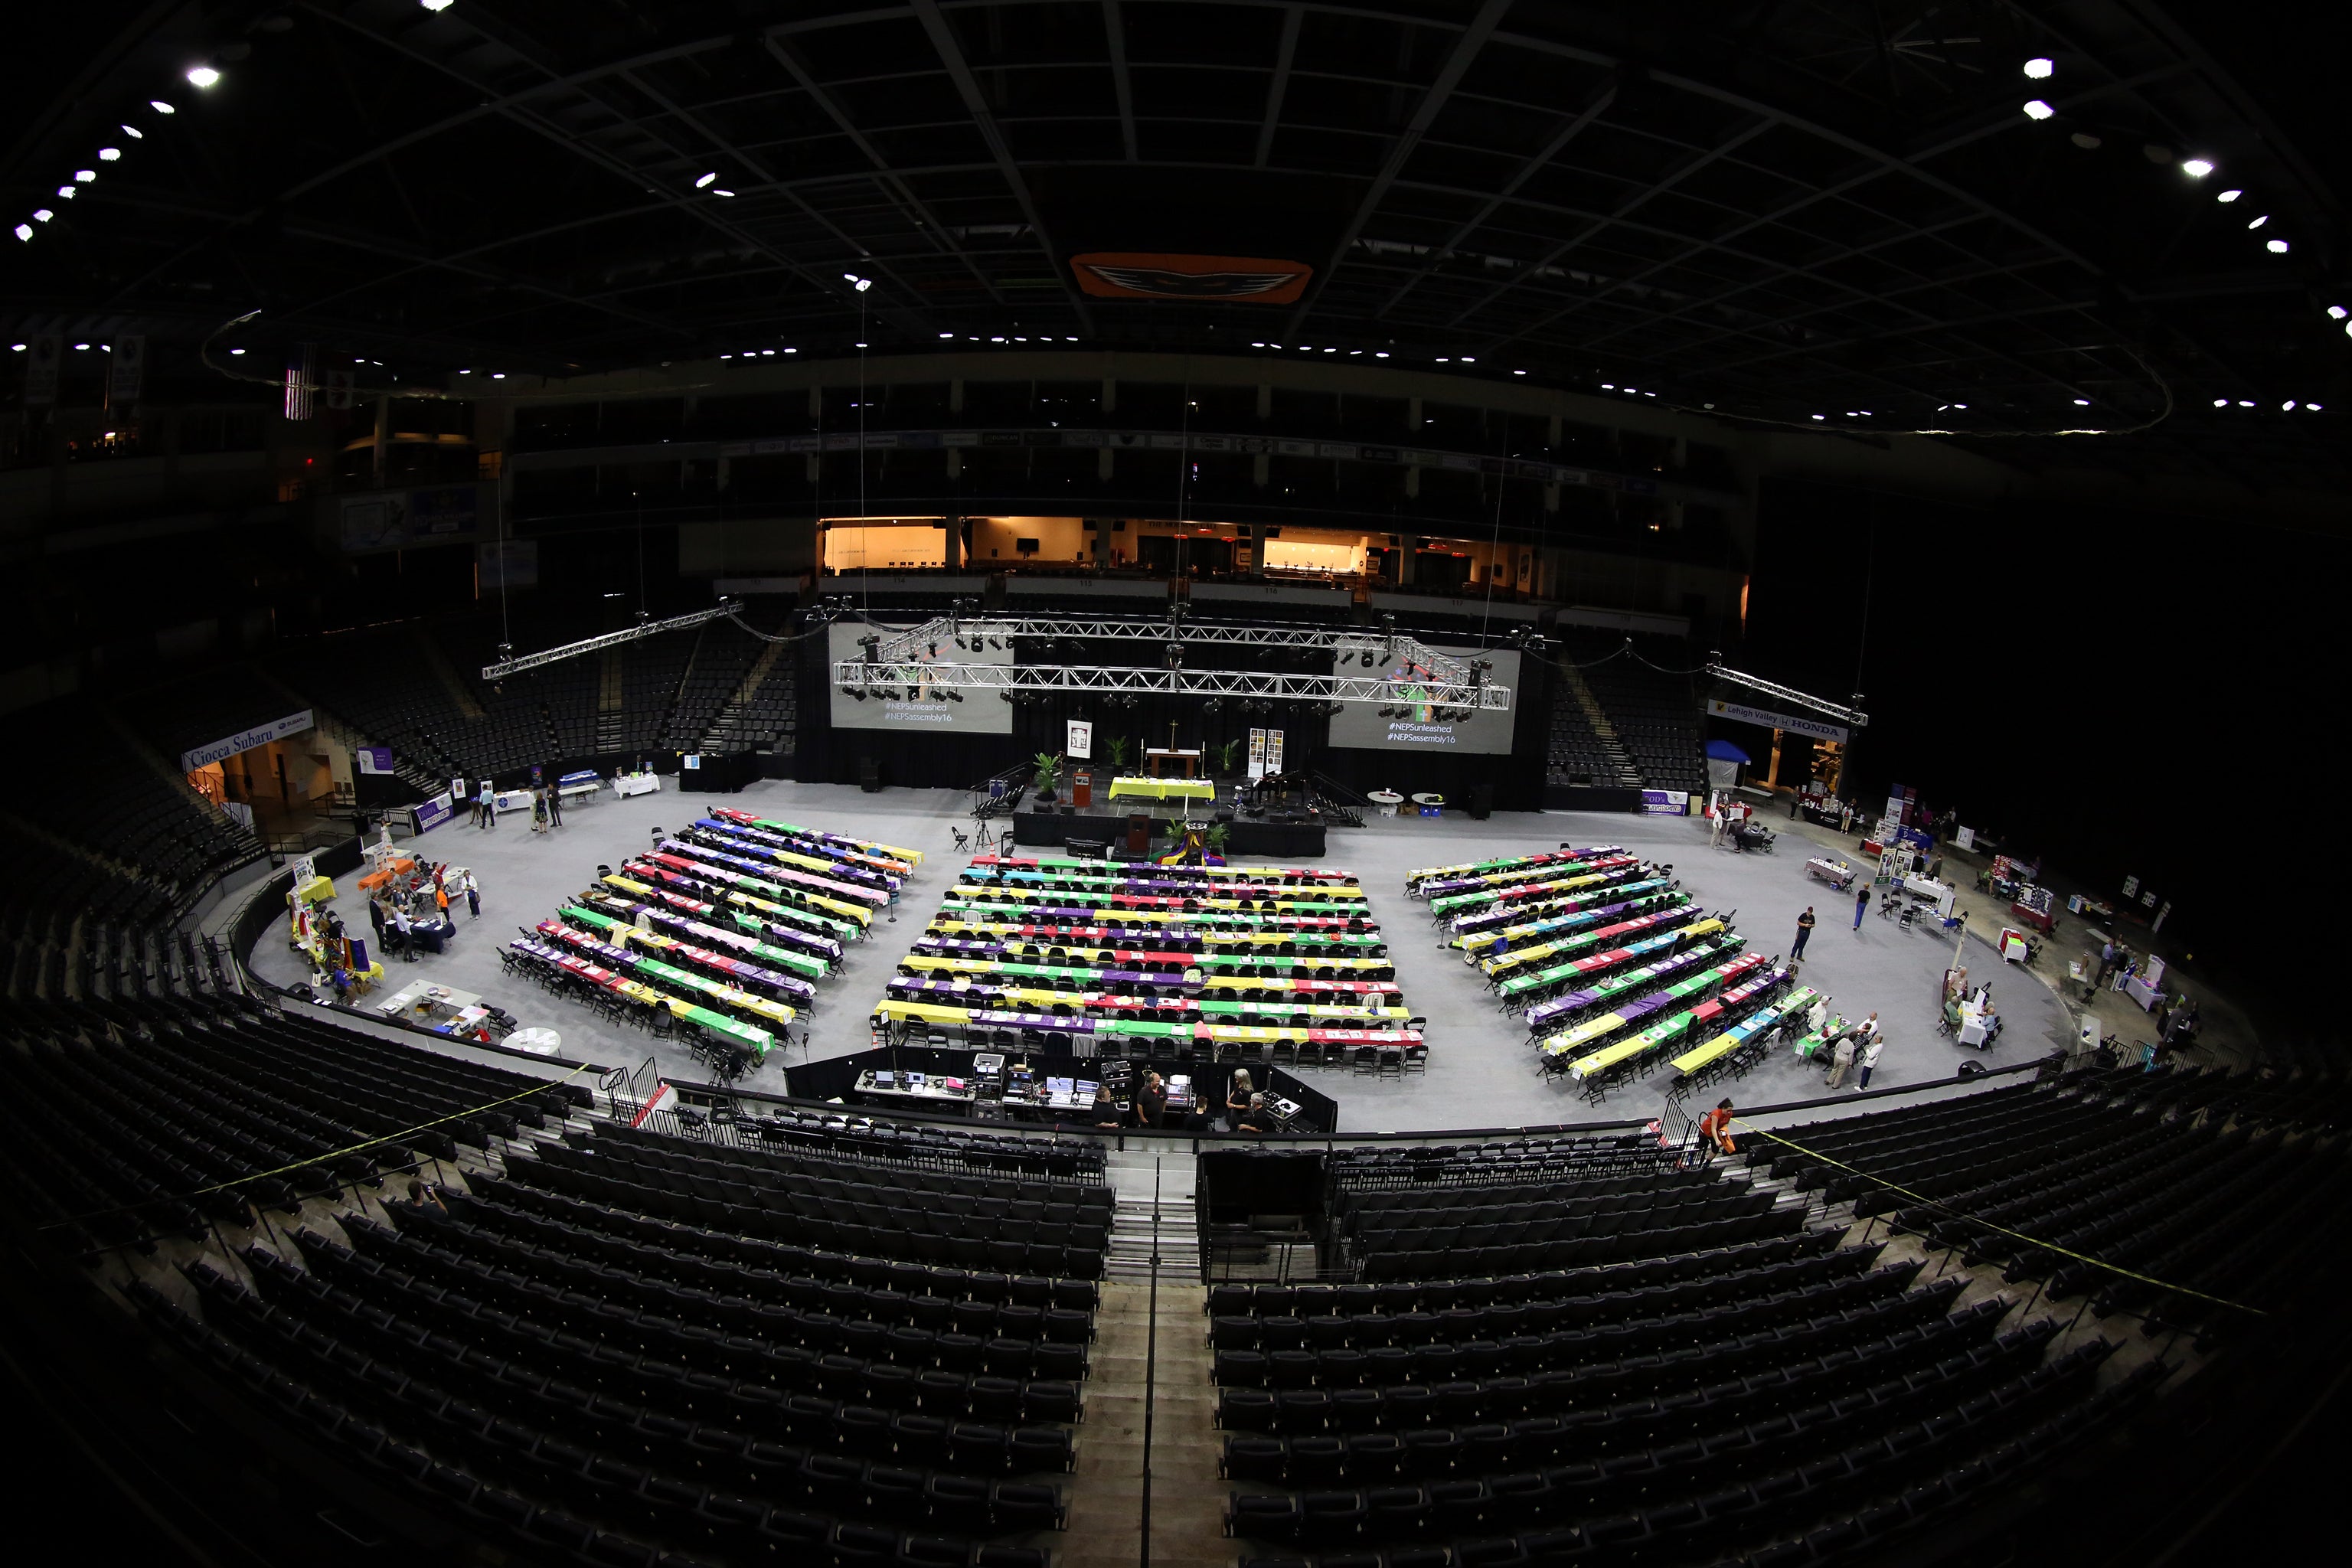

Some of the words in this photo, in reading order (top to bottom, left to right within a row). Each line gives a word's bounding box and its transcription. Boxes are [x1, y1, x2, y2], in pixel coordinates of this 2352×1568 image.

[885, 702, 947, 711] #NEPSunleashed
[884, 712, 952, 722] #NEPSassembly16
[1727, 705, 1753, 717] Lehigh
[1755, 711, 1778, 724] Valley
[1792, 720, 1839, 737] HONDA
[1388, 722, 1452, 733] #NEPSunleashed
[1387, 733, 1455, 744] #NEPSassembly16
[191, 746, 230, 767] Ciocca
[233, 730, 273, 752] Subaru
